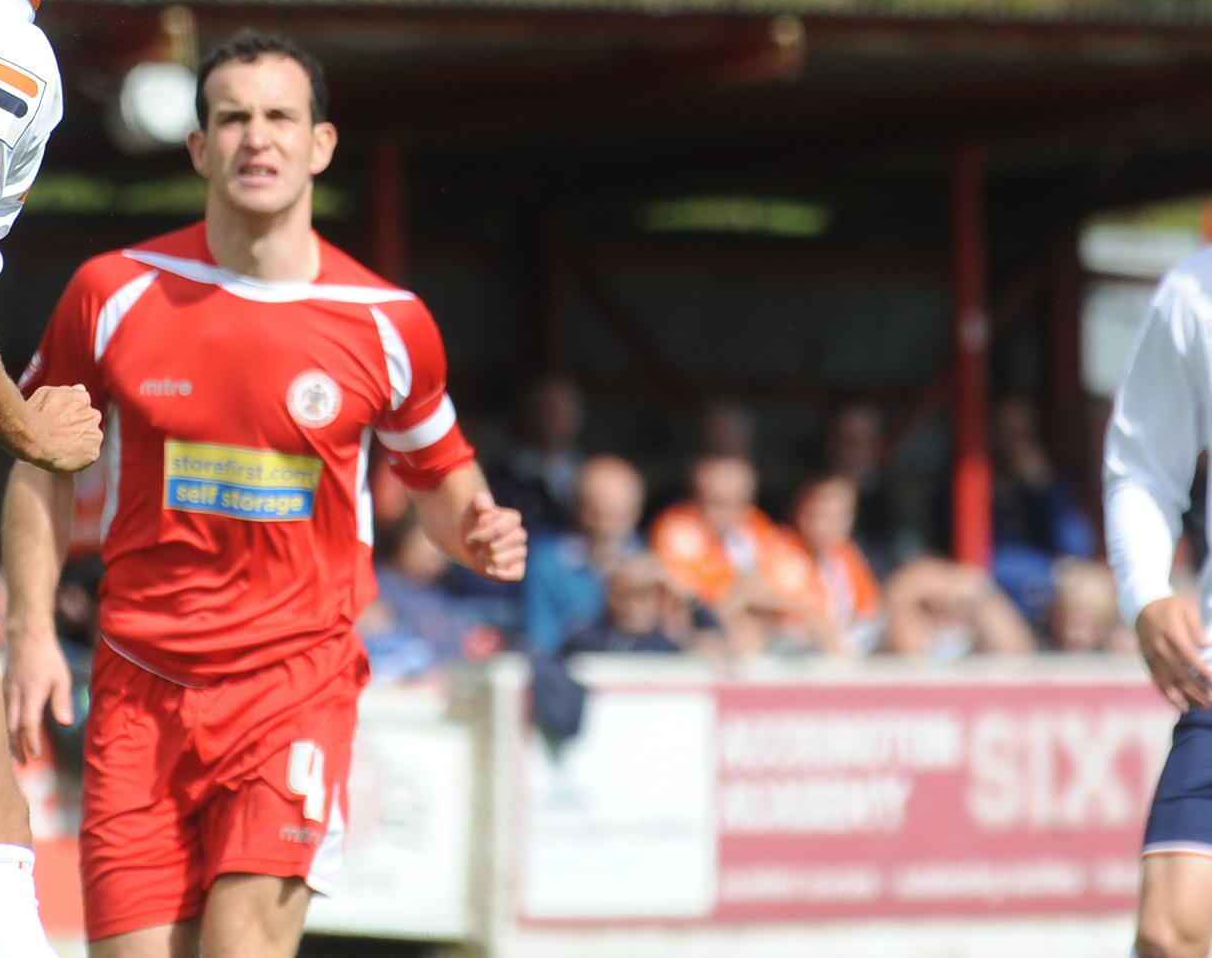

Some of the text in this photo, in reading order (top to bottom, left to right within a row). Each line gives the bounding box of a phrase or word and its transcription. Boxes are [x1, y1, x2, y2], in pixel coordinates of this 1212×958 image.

[140, 377, 192, 397] mitre
[171, 455, 315, 484] storefirst.com
[176, 483, 305, 516] self storage
[286, 739, 326, 823] 4
